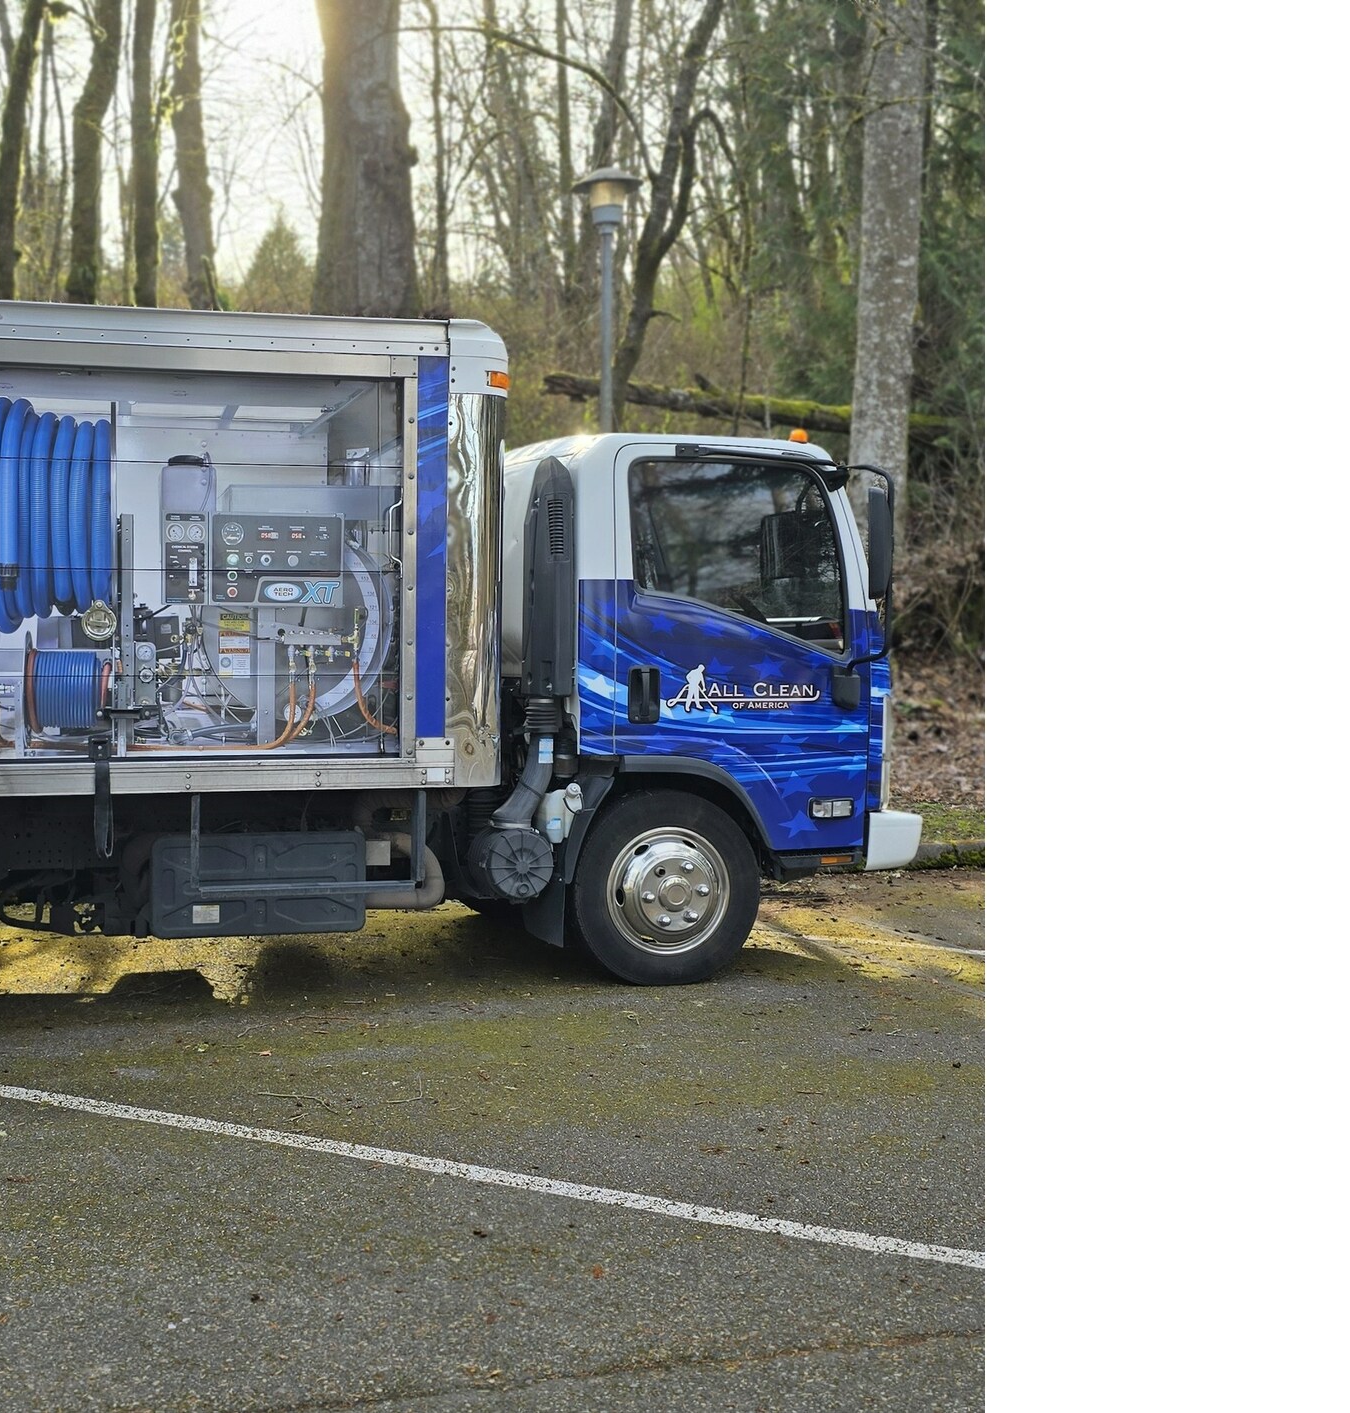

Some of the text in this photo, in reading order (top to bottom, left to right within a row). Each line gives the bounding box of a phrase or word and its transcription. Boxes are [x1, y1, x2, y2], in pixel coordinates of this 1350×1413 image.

[299, 581, 340, 604] XT
[708, 682, 814, 697] ALL CLEAN
[747, 701, 789, 709] AMERICA
